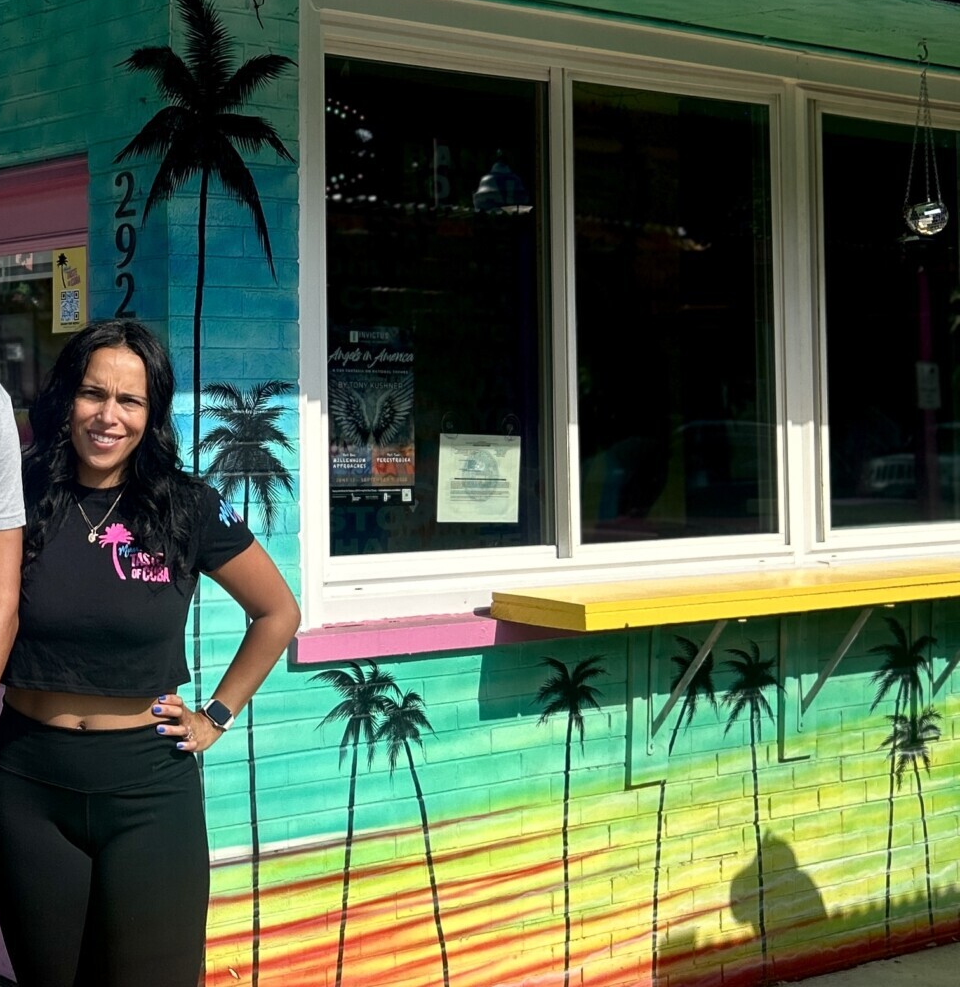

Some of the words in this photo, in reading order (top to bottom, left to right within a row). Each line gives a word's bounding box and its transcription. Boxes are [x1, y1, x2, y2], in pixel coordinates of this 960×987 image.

[328, 346, 363, 367] Angels
[362, 350, 373, 360] in
[368, 348, 414, 368] America
[349, 381, 368, 389] TONY
[370, 381, 404, 390] KUSHNER
[131, 568, 141, 580] OF
